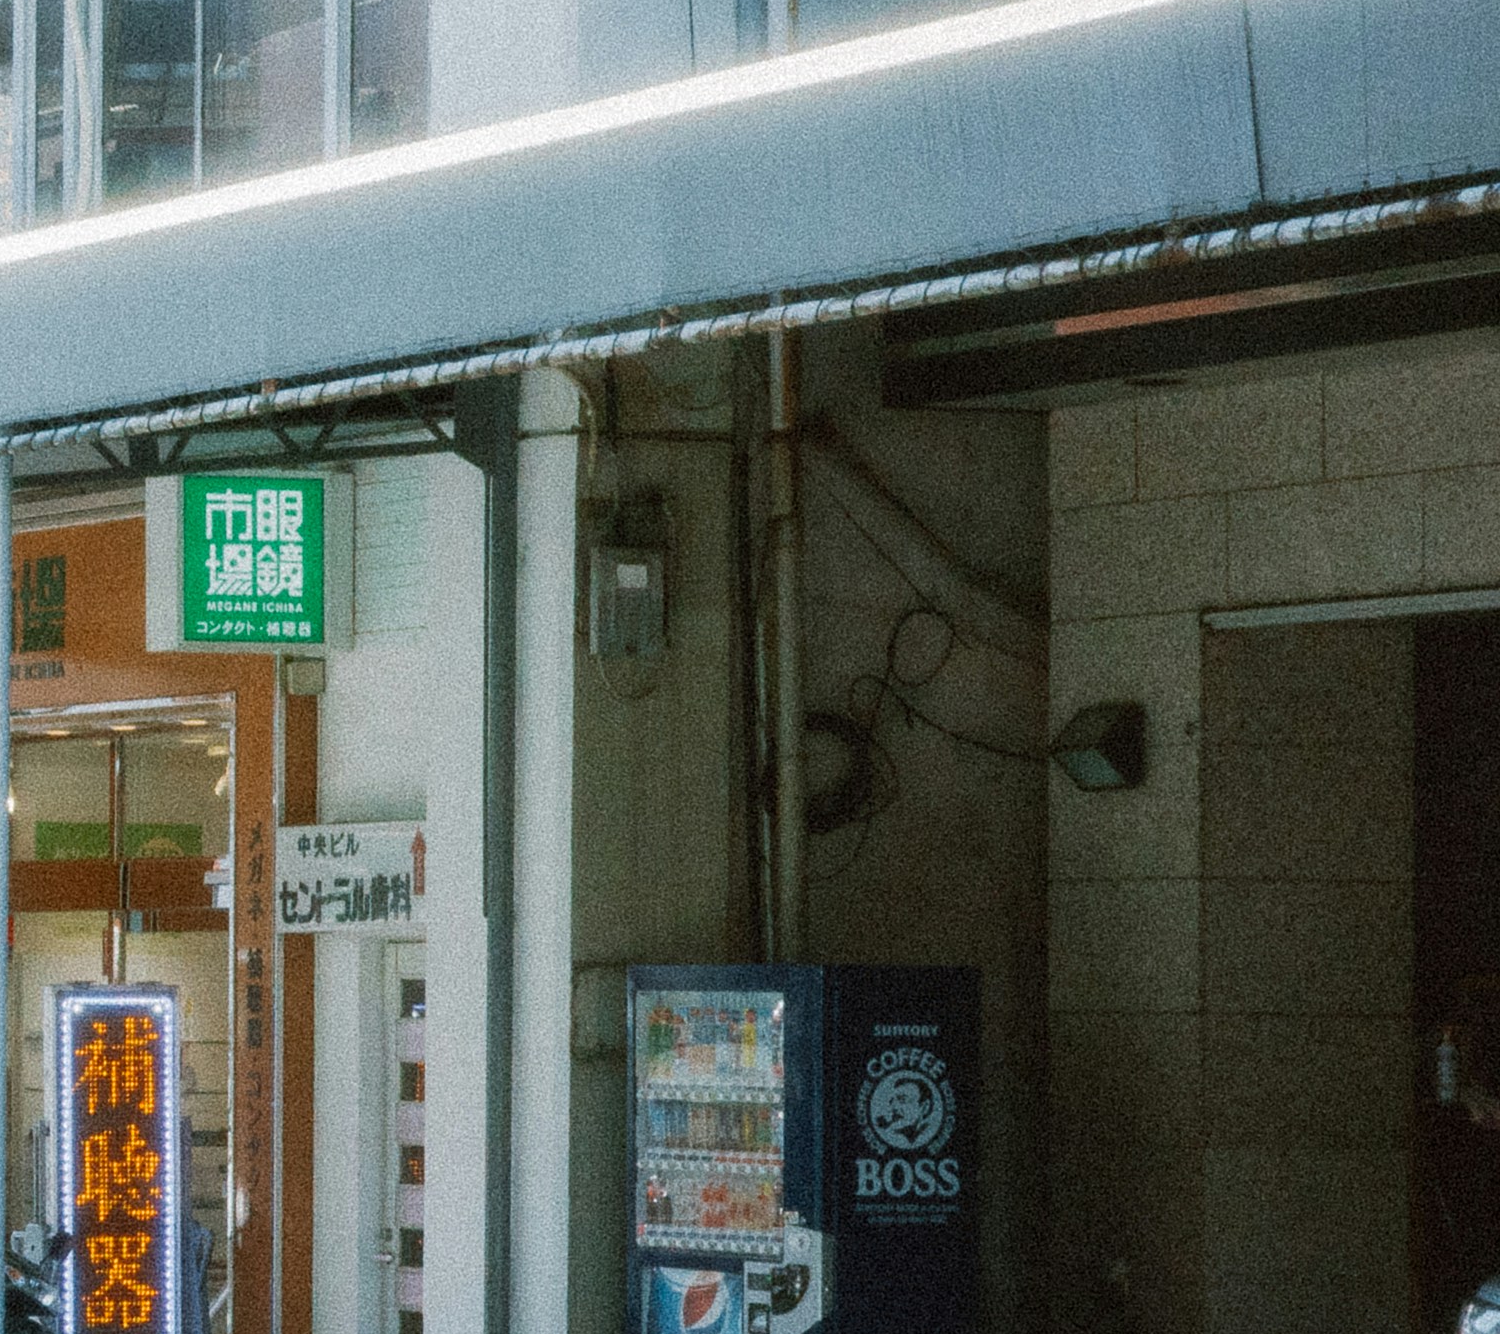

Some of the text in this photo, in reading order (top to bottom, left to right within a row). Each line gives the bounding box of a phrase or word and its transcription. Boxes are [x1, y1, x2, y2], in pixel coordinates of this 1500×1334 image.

[206, 600, 257, 613] MEGANE
[298, 832, 360, 859] 中央ビル
[279, 873, 412, 925] セントラル歯科
[867, 1047, 947, 1080] COFFEE
[71, 1015, 163, 1330] 補聴器
[855, 1158, 961, 1197] BOSS
